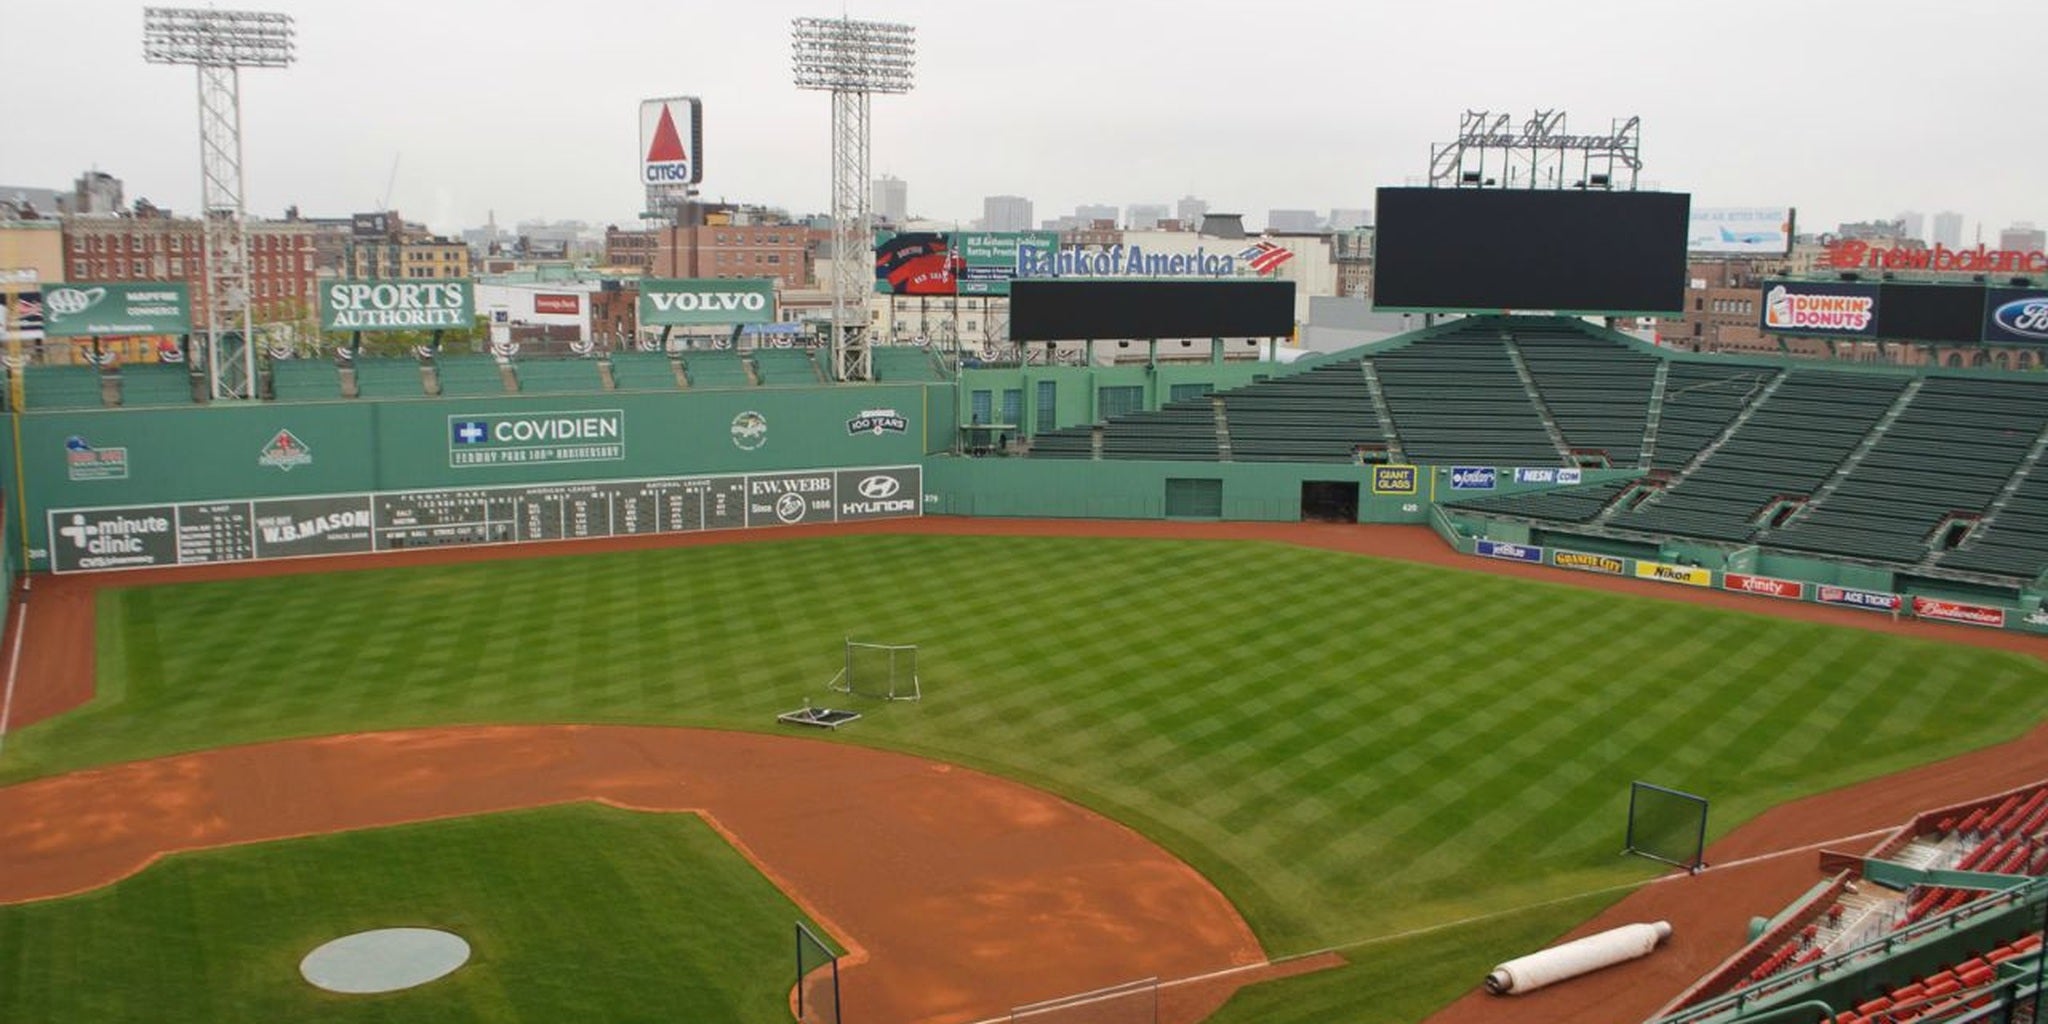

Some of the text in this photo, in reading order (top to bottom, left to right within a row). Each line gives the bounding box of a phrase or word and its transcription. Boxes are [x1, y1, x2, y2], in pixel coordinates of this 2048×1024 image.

[1512, 109, 1642, 170] Hancock
[647, 163, 687, 181] CITGO
[1018, 244, 1094, 276] Bank
[1094, 244, 1122, 276] of
[1124, 245, 1234, 276] America
[1871, 242, 2048, 272] new balanc
[330, 283, 463, 310] SPORTS
[647, 292, 765, 311] VOLVO
[1796, 298, 1869, 313] DUNKIN'
[1796, 312, 1865, 327] DONUTS
[495, 418, 618, 442] COVIDIEN
[851, 418, 904, 430] 100 YEARS
[1379, 470, 1410, 480] GIANT
[1523, 470, 1553, 481] NESN
[783, 478, 831, 493] WEBB
[1378, 479, 1411, 490] GLASS
[843, 500, 914, 515] HYUNDAI
[1402, 503, 1417, 512] 420
[98, 516, 169, 534] minute
[89, 535, 143, 554] clinic
[1654, 566, 1692, 581] Nikon
[1741, 577, 1783, 595] xfinity
[1843, 591, 1863, 603] ACE
[1920, 601, 2001, 623] Budweiser
